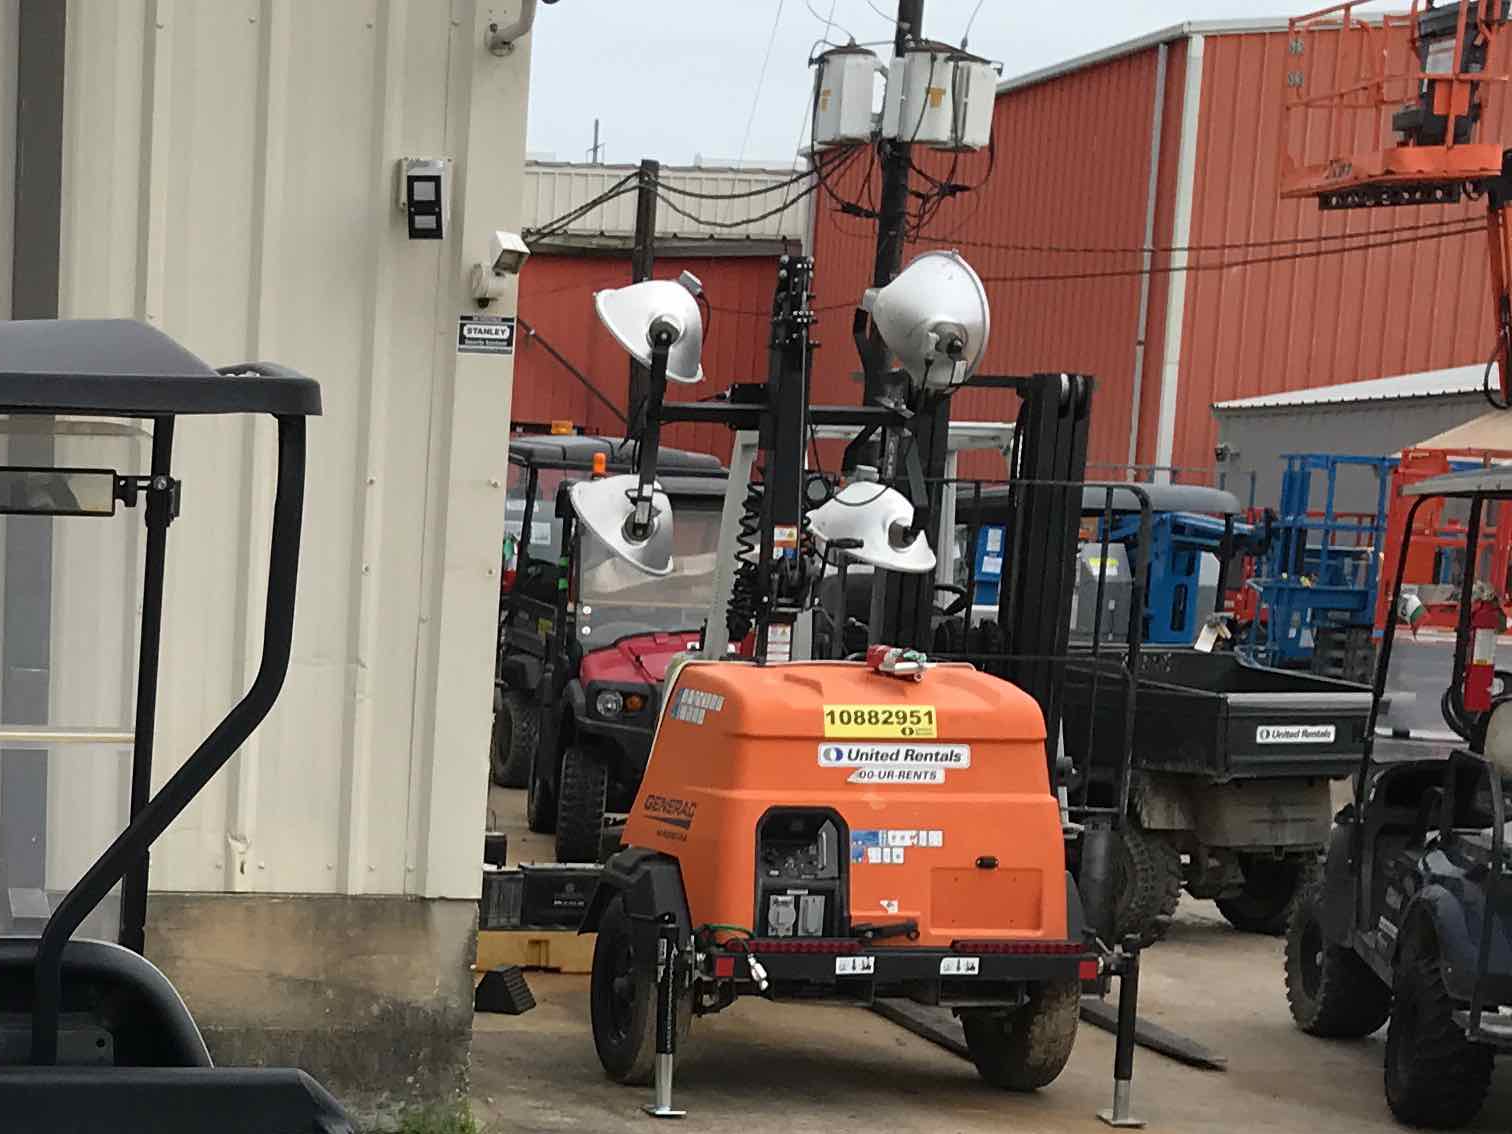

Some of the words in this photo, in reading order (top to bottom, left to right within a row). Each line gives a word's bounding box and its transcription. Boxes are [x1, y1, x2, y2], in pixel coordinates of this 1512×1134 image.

[466, 326, 507, 337] STANLEY
[825, 709, 934, 726] 10882951
[1271, 728, 1301, 739] United
[847, 747, 901, 763] United
[903, 748, 962, 763] Rentals
[644, 794, 696, 818] GENERAC
